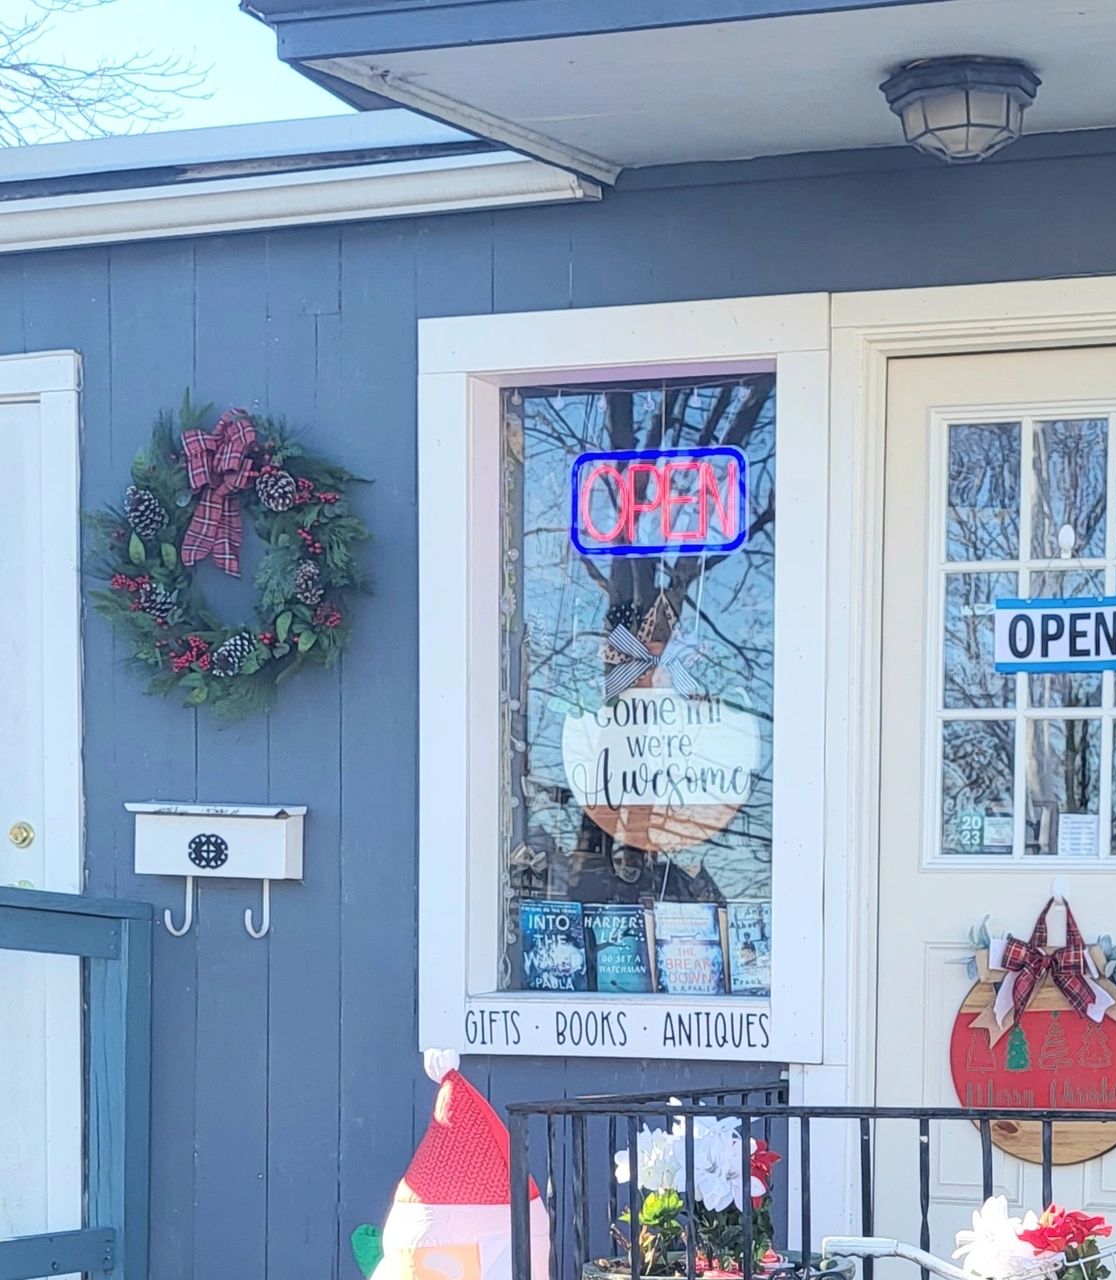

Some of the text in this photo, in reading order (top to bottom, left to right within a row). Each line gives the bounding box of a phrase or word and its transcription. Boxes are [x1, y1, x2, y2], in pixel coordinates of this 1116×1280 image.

[581, 461, 737, 542] OPEN
[625, 733, 693, 758] we're
[572, 747, 750, 811] Awesome
[528, 913, 570, 931] INTO
[584, 915, 639, 929] HARPER
[535, 976, 575, 991] PAULA
[464, 1009, 770, 1049] GIFTS BOOKS ANTIQUES
